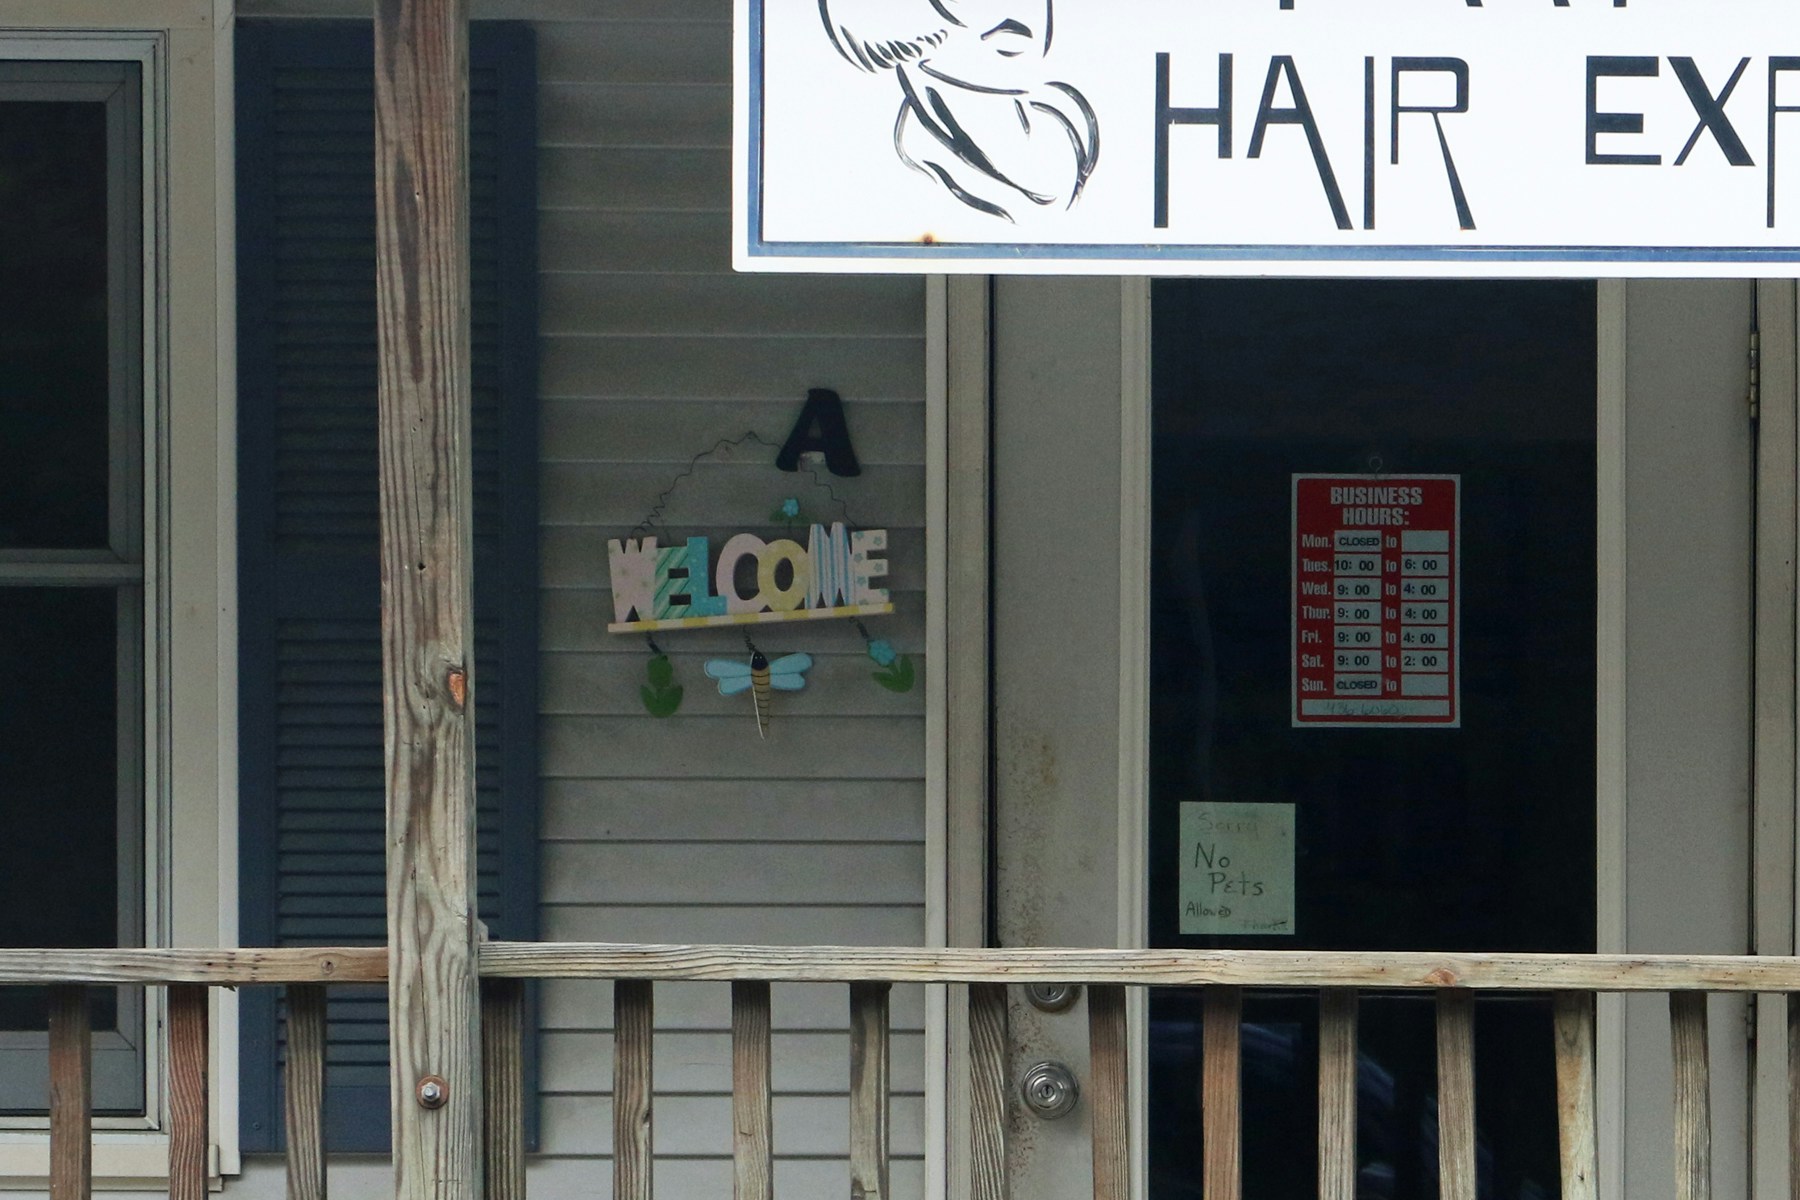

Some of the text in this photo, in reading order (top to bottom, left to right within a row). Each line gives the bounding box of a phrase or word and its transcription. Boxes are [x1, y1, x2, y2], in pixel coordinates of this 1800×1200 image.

[1153, 52, 1476, 231] HAIR
[776, 388, 861, 477] A
[1330, 486, 1423, 505] BUSINESS
[1343, 507, 1410, 526] HOURS:
[1302, 534, 1397, 548] Mon. CLOSED to
[608, 522, 890, 623] WELCOME
[1302, 559, 1332, 572] Tues.
[1386, 560, 1397, 572] to
[1302, 582, 1331, 595] Wed.
[1386, 582, 1397, 595] to
[1302, 606, 1331, 619] Thur.
[1386, 606, 1397, 619] to
[1302, 630, 1322, 643] Fri.
[1386, 631, 1397, 643] to
[1302, 654, 1324, 668] Sat.
[1386, 655, 1397, 668] to
[1302, 678, 1397, 691] Sun. CLOSED to
[1194, 841, 1231, 869] No
[1208, 871, 1264, 896] Pets
